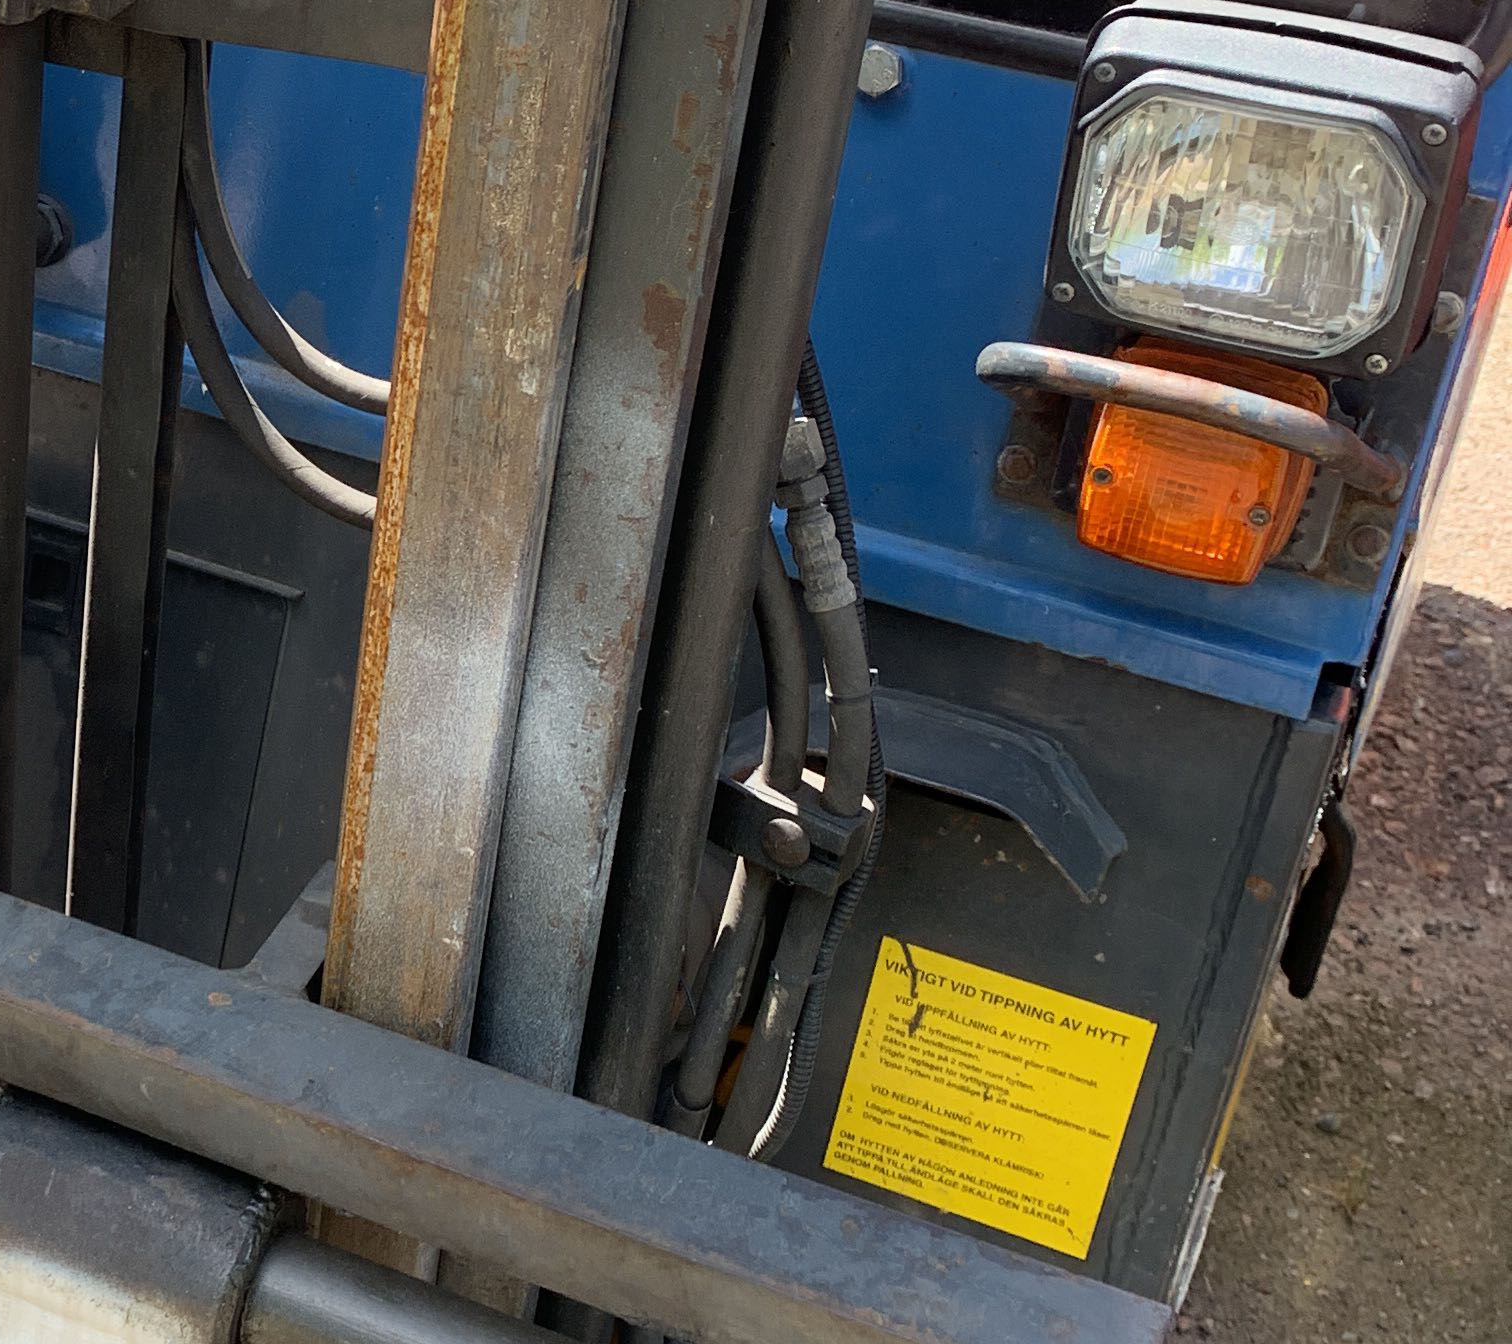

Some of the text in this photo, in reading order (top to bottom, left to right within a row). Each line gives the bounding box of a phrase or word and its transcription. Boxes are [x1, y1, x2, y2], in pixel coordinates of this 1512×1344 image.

[884, 1024, 906, 1037] Drag
[894, 994, 913, 1008] VID
[999, 1029, 1016, 1041] AV
[948, 979, 977, 998] VID
[977, 989, 1056, 1024] TIPPNING
[1058, 1015, 1082, 1032] AV
[1085, 1023, 1130, 1048] HYTT
[869, 1083, 889, 1097] VID
[974, 1119, 990, 1132] AV
[833, 1150, 871, 1169] GENOM
[838, 1129, 855, 1141] OM
[859, 1136, 900, 1156] HYTTEN
[902, 1151, 916, 1162] AV
[958, 1171, 1019, 1198] ANLEDNING
[1020, 1193, 1044, 1207] INTE
[1046, 1200, 1071, 1216] GÅR
[933, 1136, 991, 1161] OBSERVERA
[836, 1140, 854, 1152] ATT
[856, 1147, 884, 1162] TIPPA
[886, 1157, 906, 1170] TILL
[961, 1184, 994, 1201] SKALL
[997, 1196, 1020, 1210] DEN
